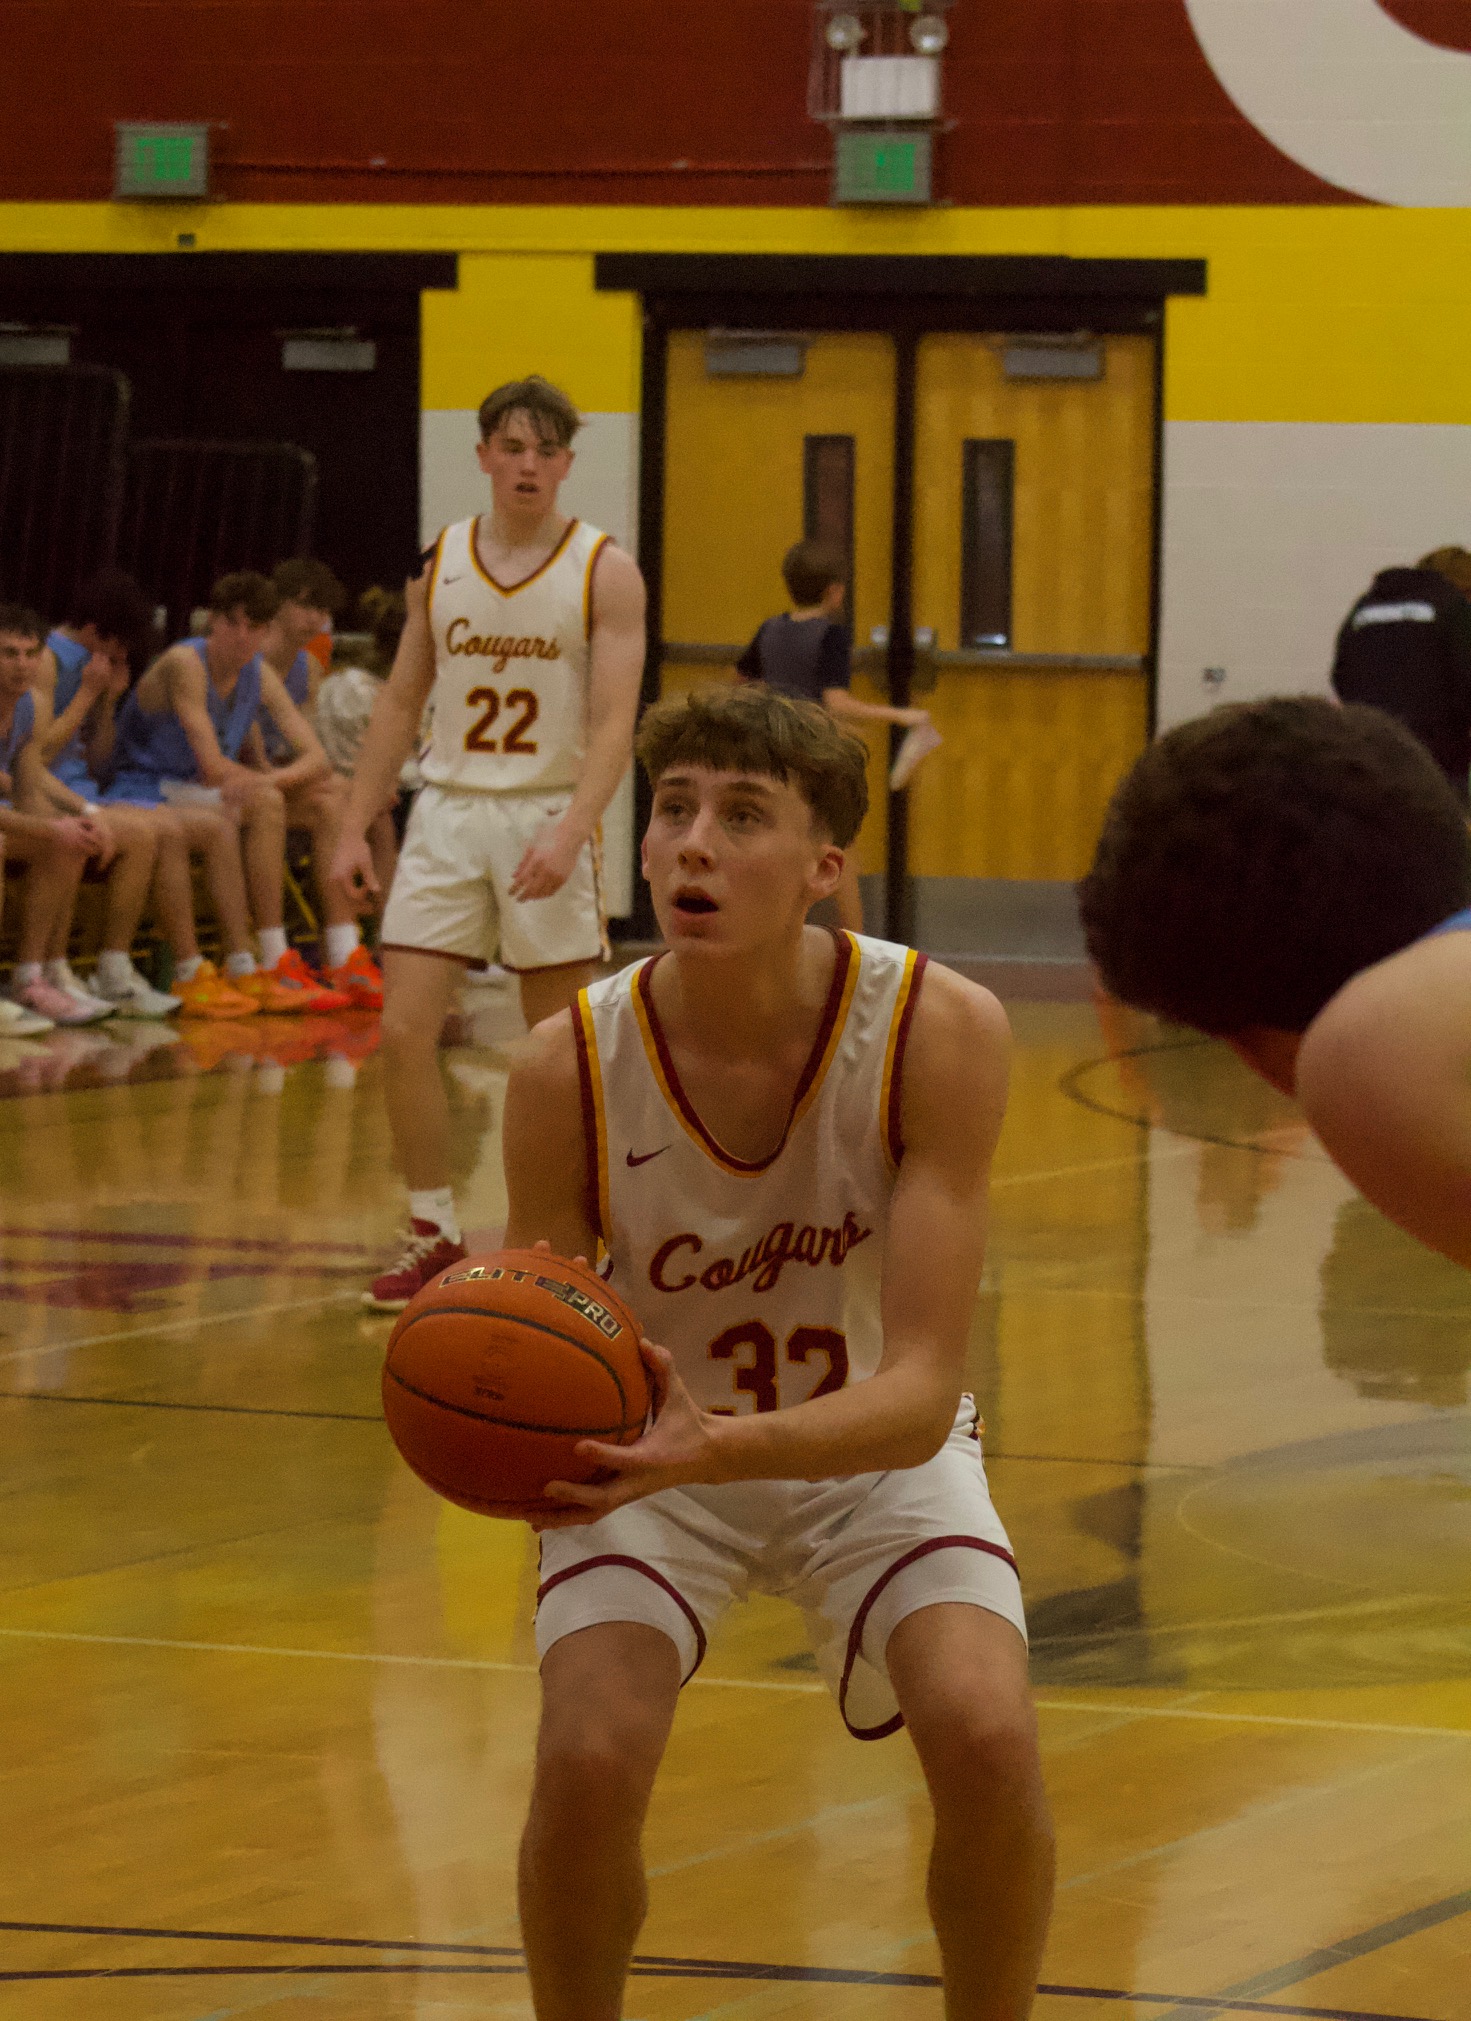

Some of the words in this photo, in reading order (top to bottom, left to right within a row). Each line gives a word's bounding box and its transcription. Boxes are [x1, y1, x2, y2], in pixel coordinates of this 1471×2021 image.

[445, 617, 561, 674] Cougars
[464, 686, 539, 754] 22
[648, 1210, 874, 1292] Cougars
[438, 1266, 568, 1297] ELITE
[567, 1288, 622, 1338] PRO
[706, 1318, 850, 1417] 32
